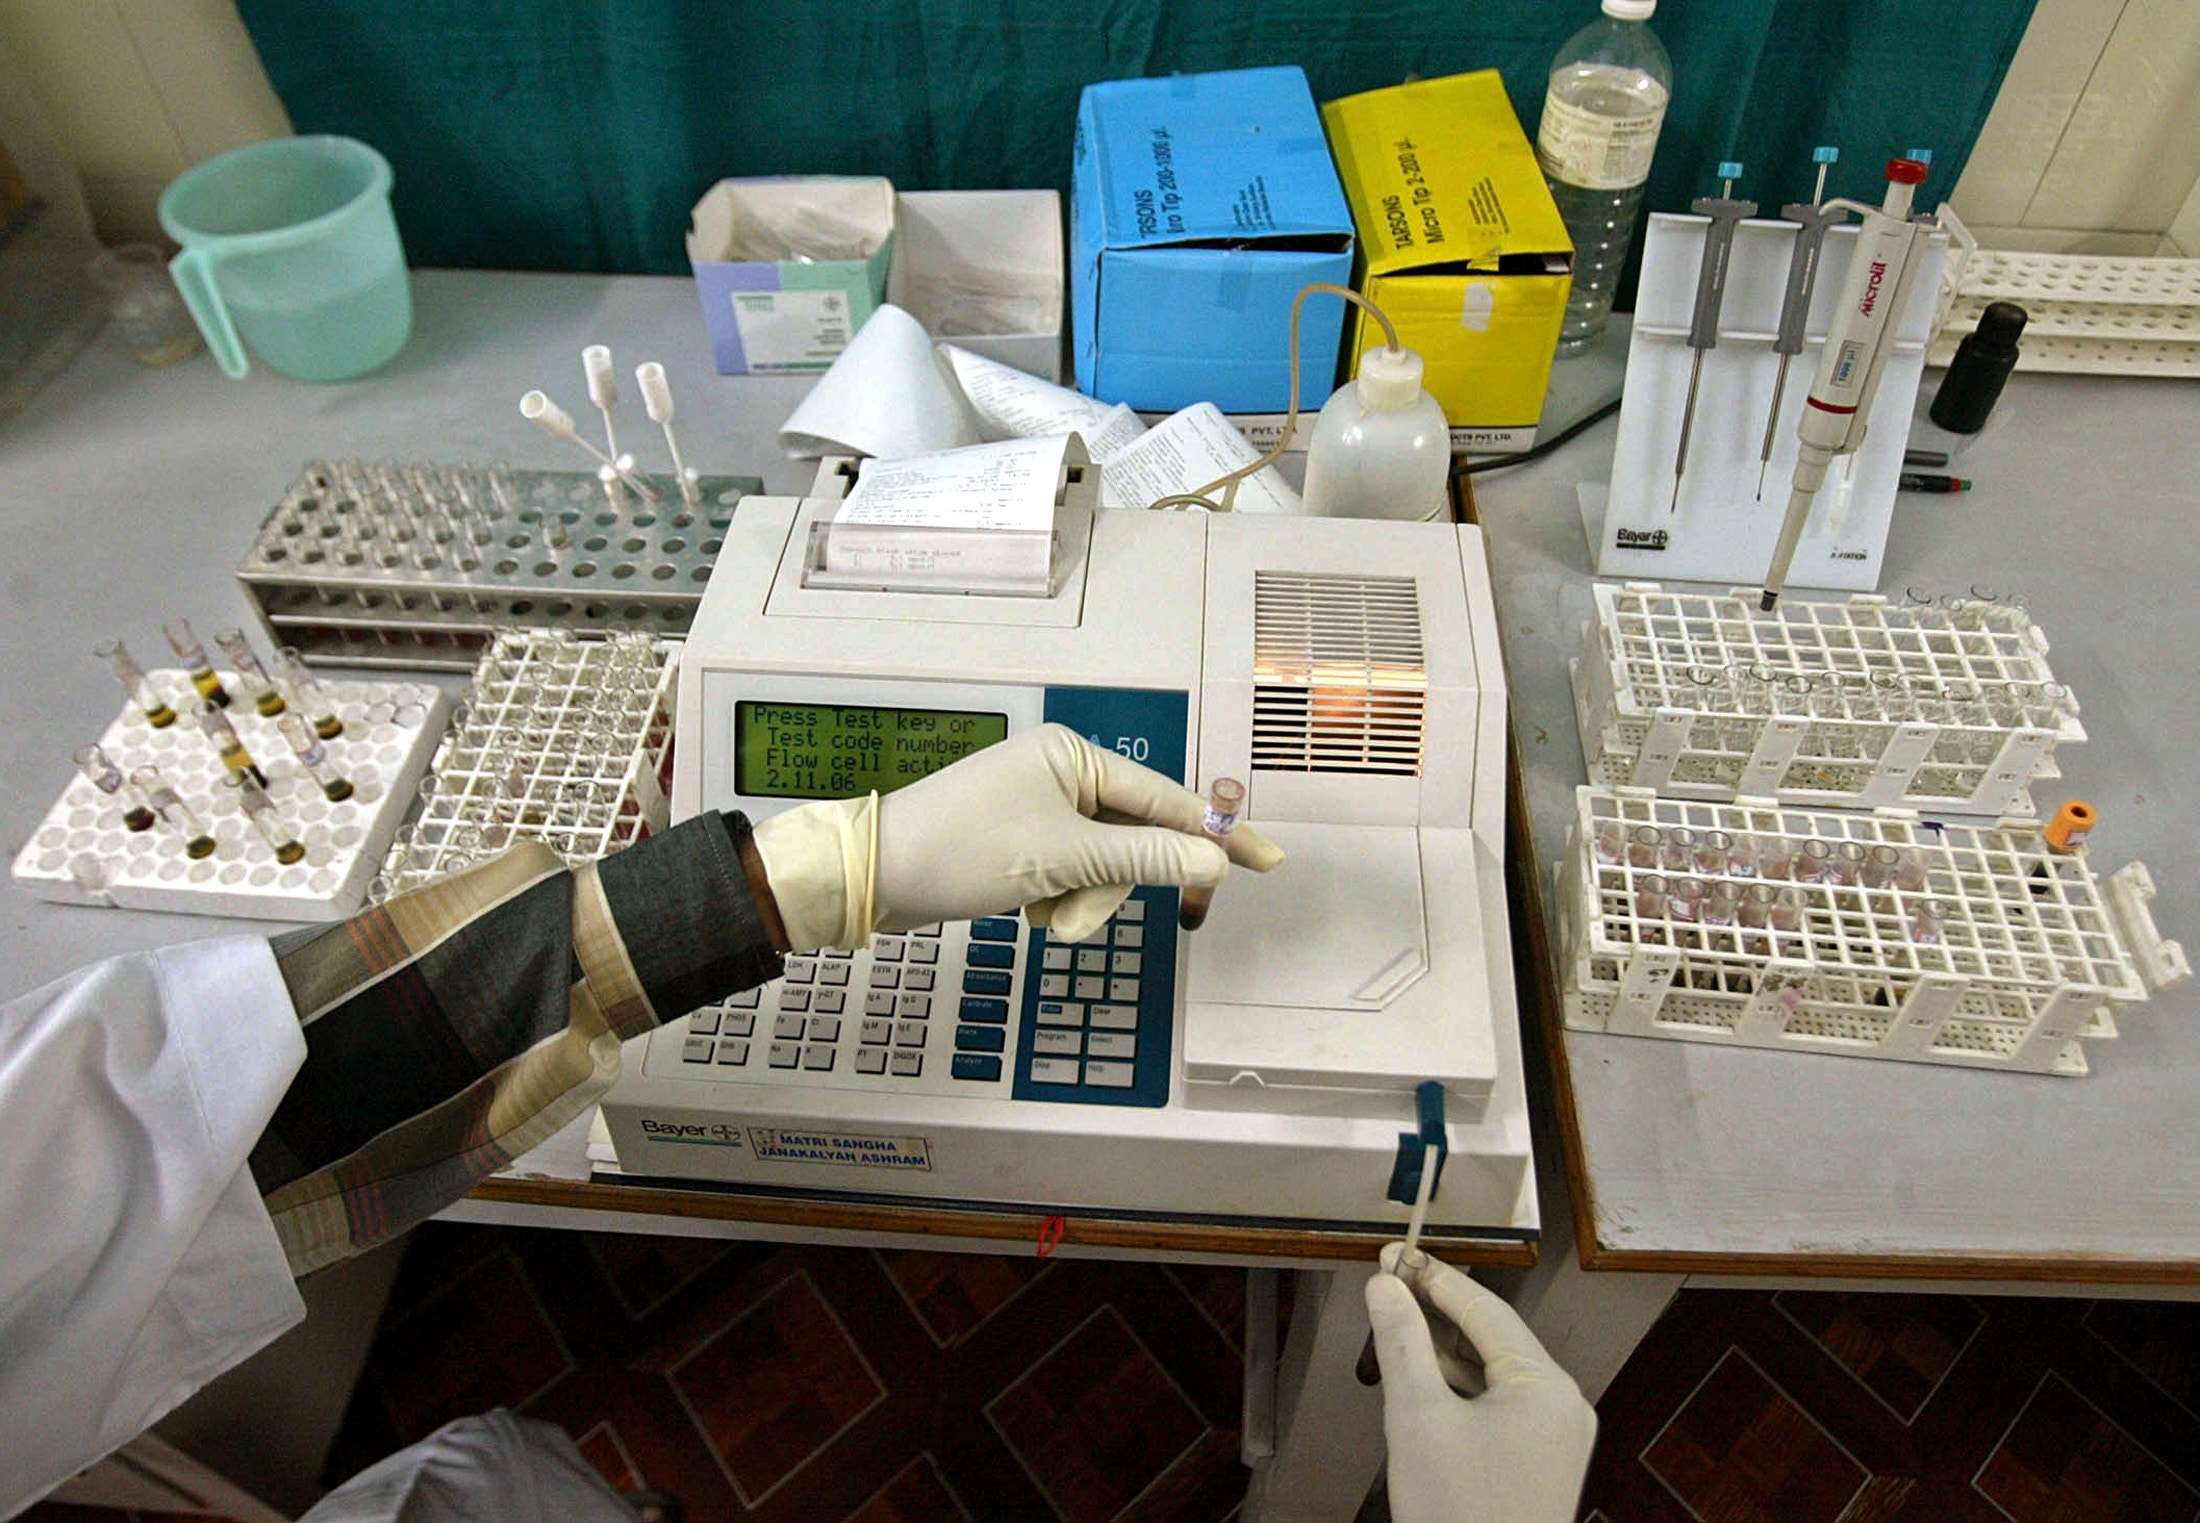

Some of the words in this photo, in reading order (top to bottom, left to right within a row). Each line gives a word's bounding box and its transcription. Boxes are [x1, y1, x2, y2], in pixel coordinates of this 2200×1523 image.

[1398, 153, 1425, 186] 2-200
[1161, 192, 1183, 213] Tip
[1412, 187, 1432, 206] Tip
[1133, 189, 1158, 238] RSONS
[1381, 194, 1414, 249] TARSONS
[1421, 207, 1445, 244] Micro
[1617, 528, 1652, 543] Bayer
[753, 705, 818, 727] Press
[832, 707, 884, 730] Test
[896, 711, 937, 732] key
[950, 718, 976, 734] or
[767, 726, 818, 748] Test
[831, 730, 884, 751] code
[896, 734, 976, 755] number
[766, 748, 818, 769] Flow
[831, 752, 881, 772] cell
[766, 769, 857, 792] 2.11.06
[1036, 1032, 1067, 1042] Program
[641, 1119, 706, 1138] Bayer
[780, 1134, 828, 1148] MATRI
[832, 1138, 896, 1152] SANGHA
[758, 1146, 857, 1162] JANAKALYAN
[860, 1152, 926, 1167] ASHRAM
